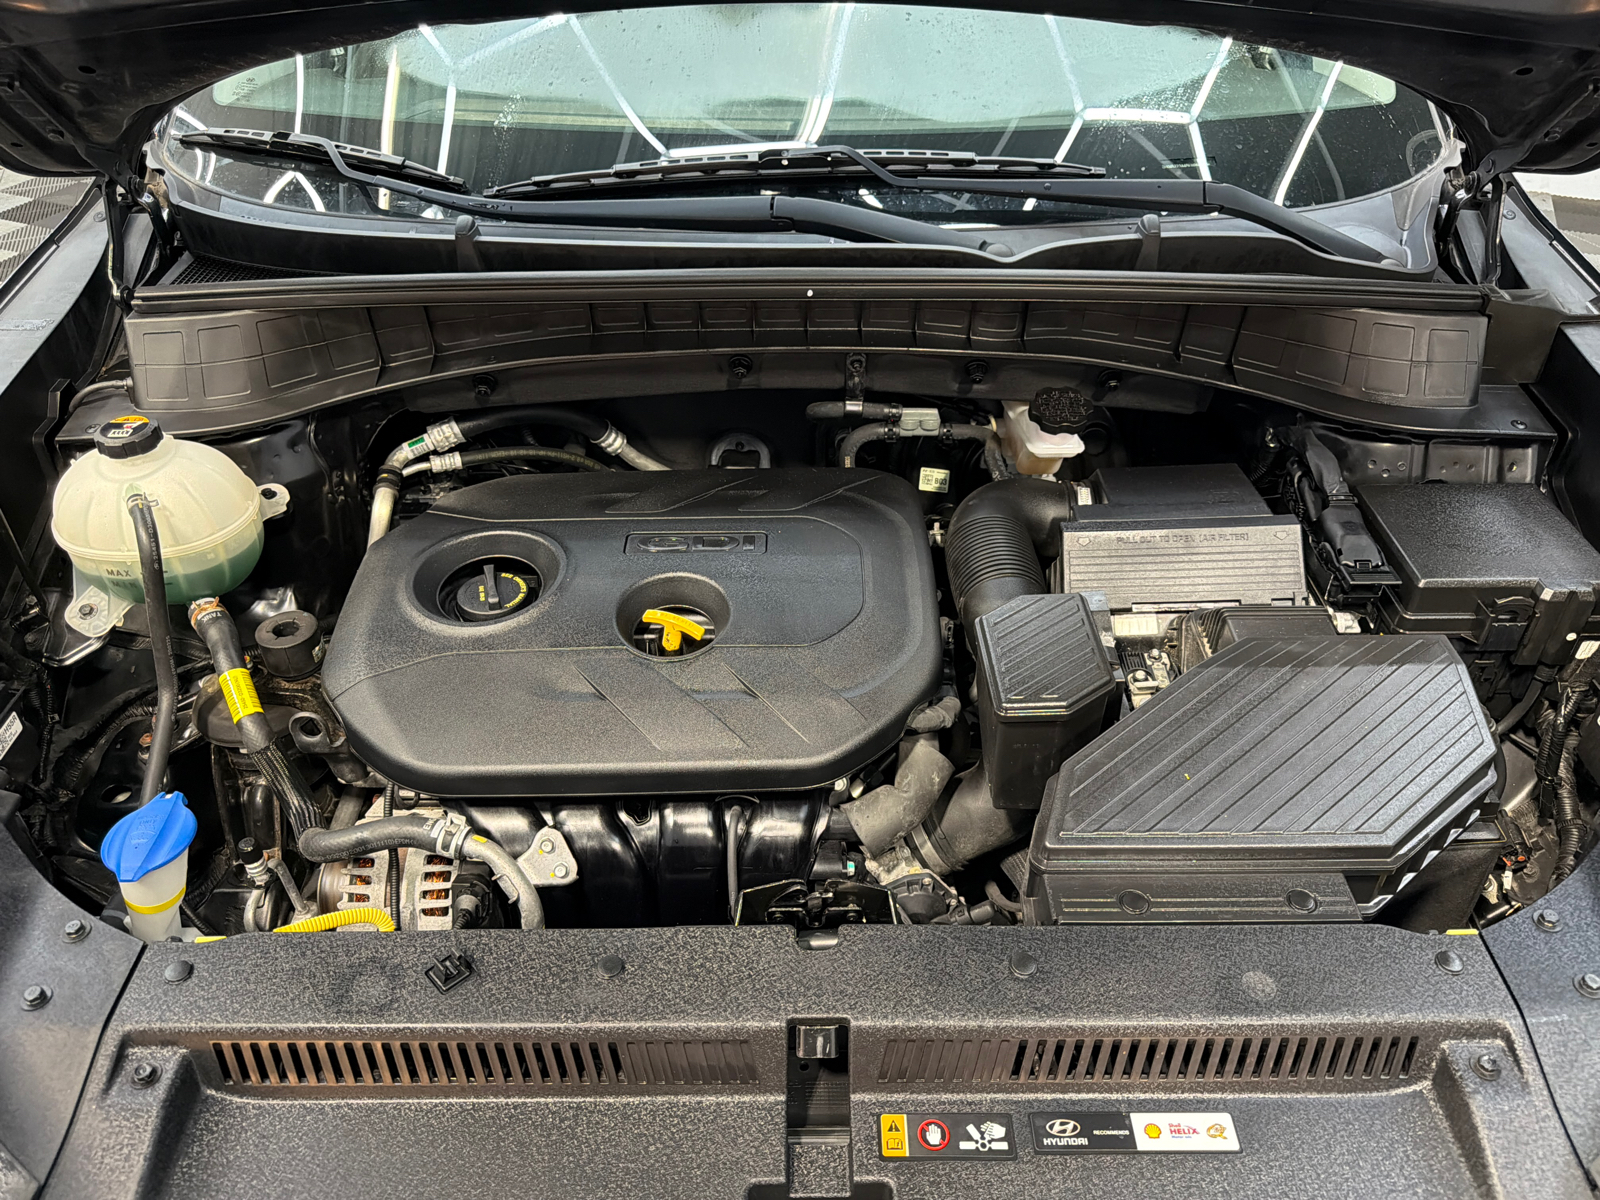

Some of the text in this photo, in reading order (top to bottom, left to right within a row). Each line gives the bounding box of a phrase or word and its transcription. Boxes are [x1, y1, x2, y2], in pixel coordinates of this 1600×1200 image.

[637, 535, 756, 552] GDI
[1116, 536, 1138, 544] PULL
[1172, 534, 1195, 543] OPEN
[105, 568, 132, 578] MAX
[111, 580, 138, 589] MIN
[201, 610, 223, 623] TANK
[1043, 1137, 1089, 1146] HYUNDAI
